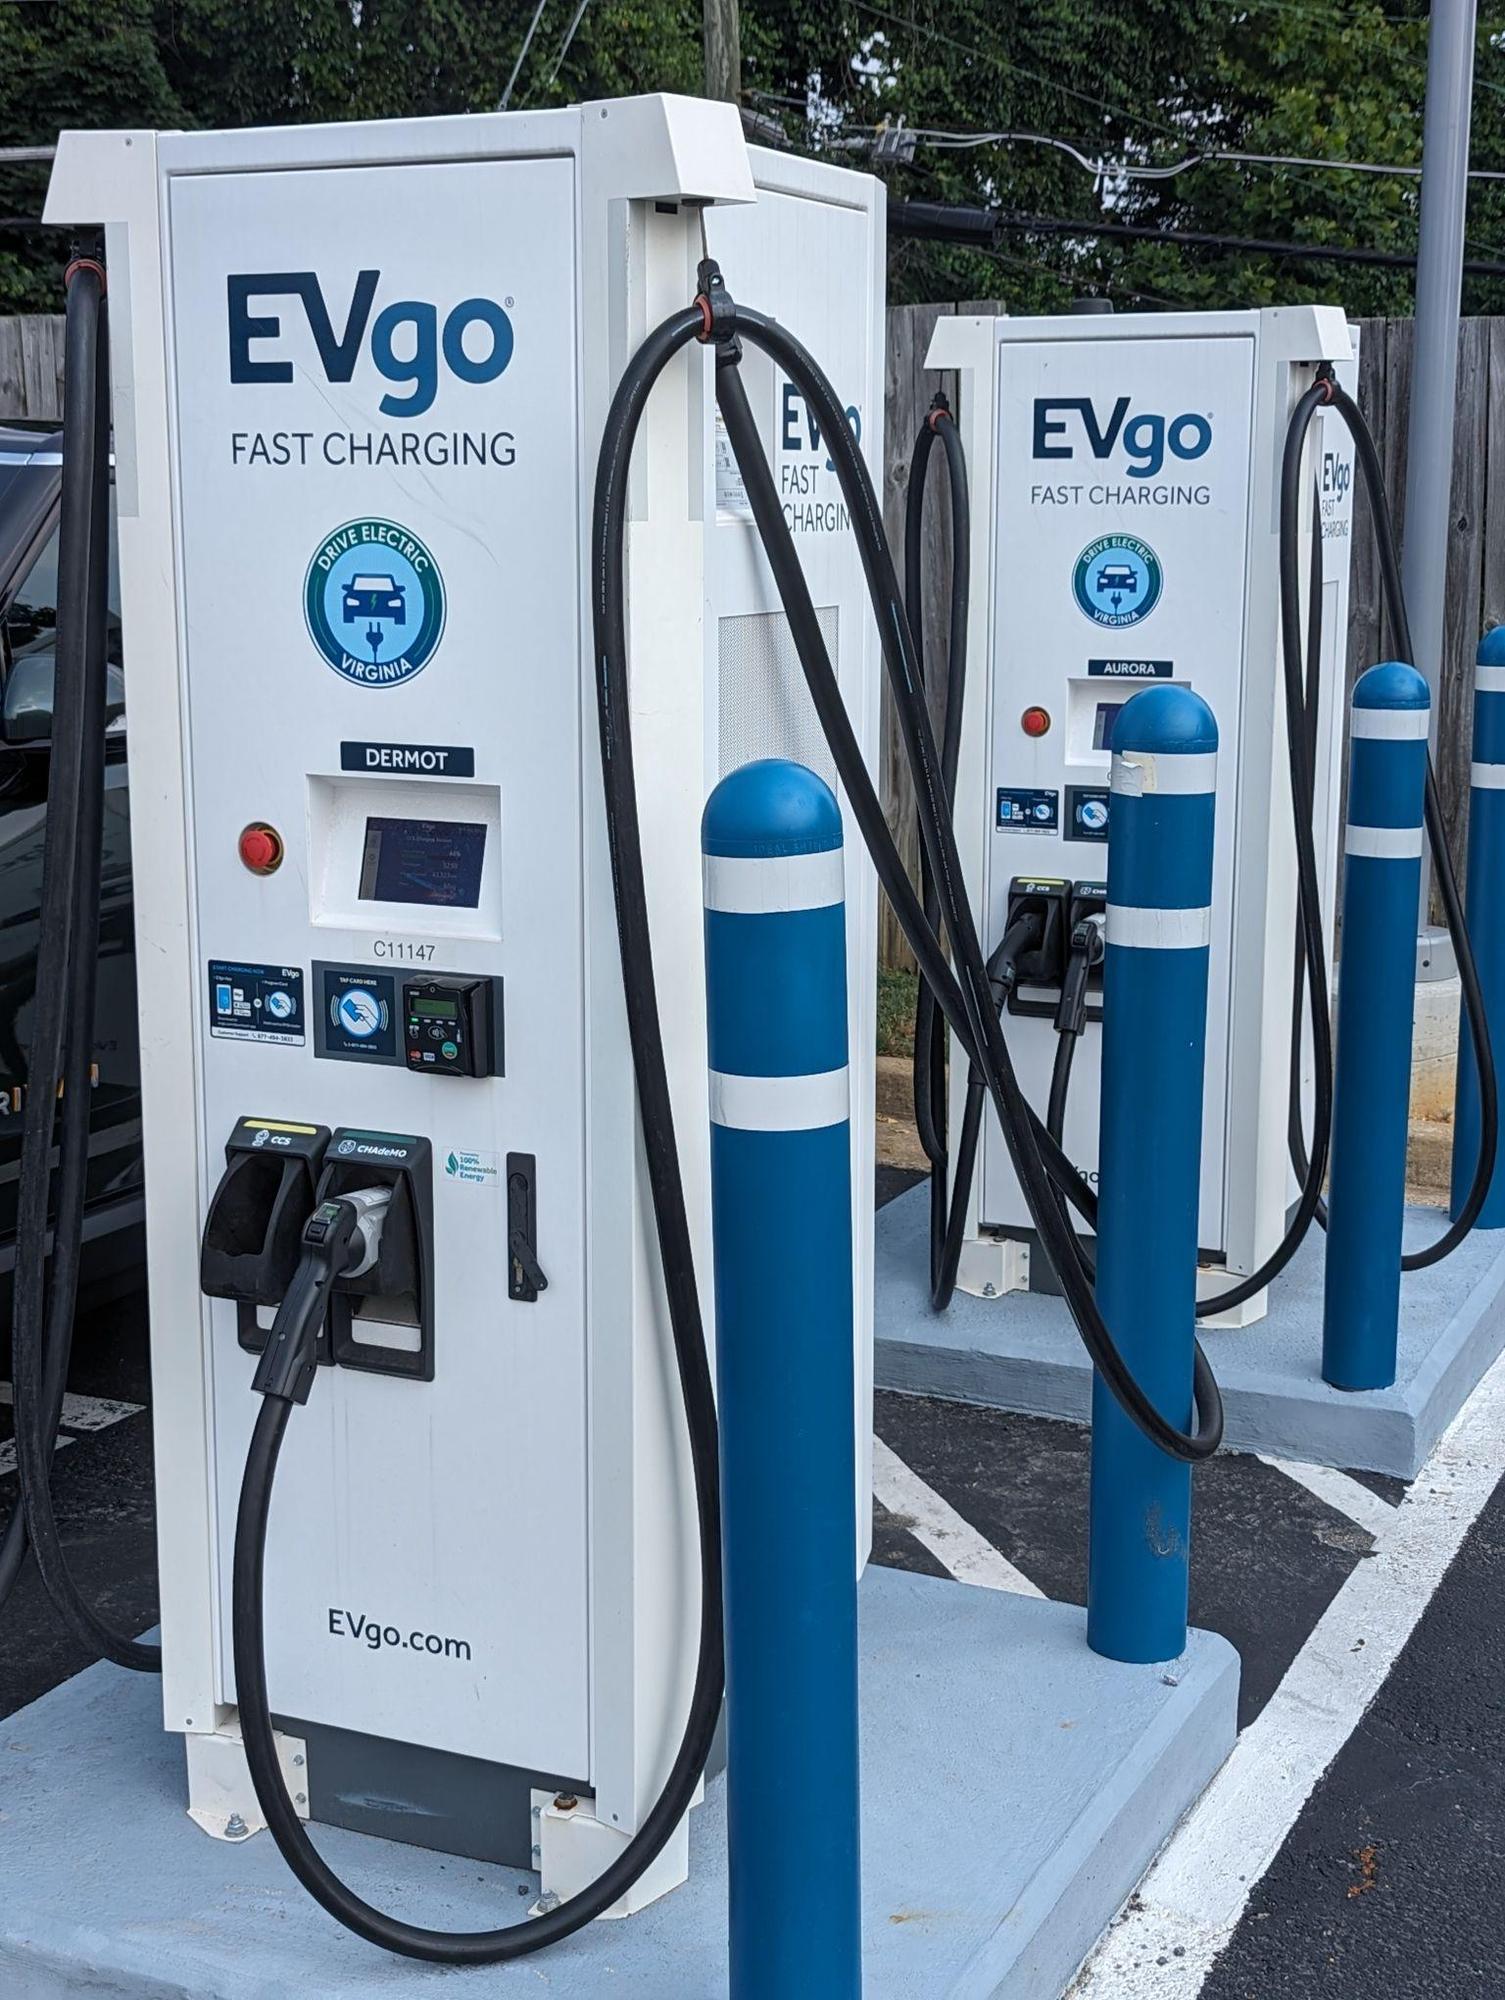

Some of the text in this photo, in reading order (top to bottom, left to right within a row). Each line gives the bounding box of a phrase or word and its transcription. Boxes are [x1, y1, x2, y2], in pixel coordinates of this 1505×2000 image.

[227, 269, 514, 418] EVgo
[1033, 397, 1212, 478] EVgo
[232, 431, 516, 466] FAST CHARGING
[782, 465, 819, 494] FAST
[1323, 452, 1350, 503] EVgo
[1031, 485, 1210, 506] FAST CHARGING
[782, 503, 851, 532] CHARGIN
[317, 524, 430, 575] DRIVE ELECTRIC
[1082, 536, 1155, 565] DRIVE ELECTRIC
[1093, 609, 1140, 626] VIRGINIA
[340, 652, 414, 683] VIRGINIA
[1103, 662, 1156, 675] AURORA
[366, 748, 449, 770] DERMOT
[374, 940, 436, 961] C11147
[281, 968, 300, 979] EVgo
[349, 977, 363, 985] CARD
[271, 1136, 292, 1146] CCS
[356, 1144, 408, 1158] CHAdeMO
[459, 1164, 498, 1175] Renewable
[460, 1156, 480, 1165] 100%
[459, 1172, 485, 1182] Energy
[328, 1608, 472, 1661] EVgo.com
